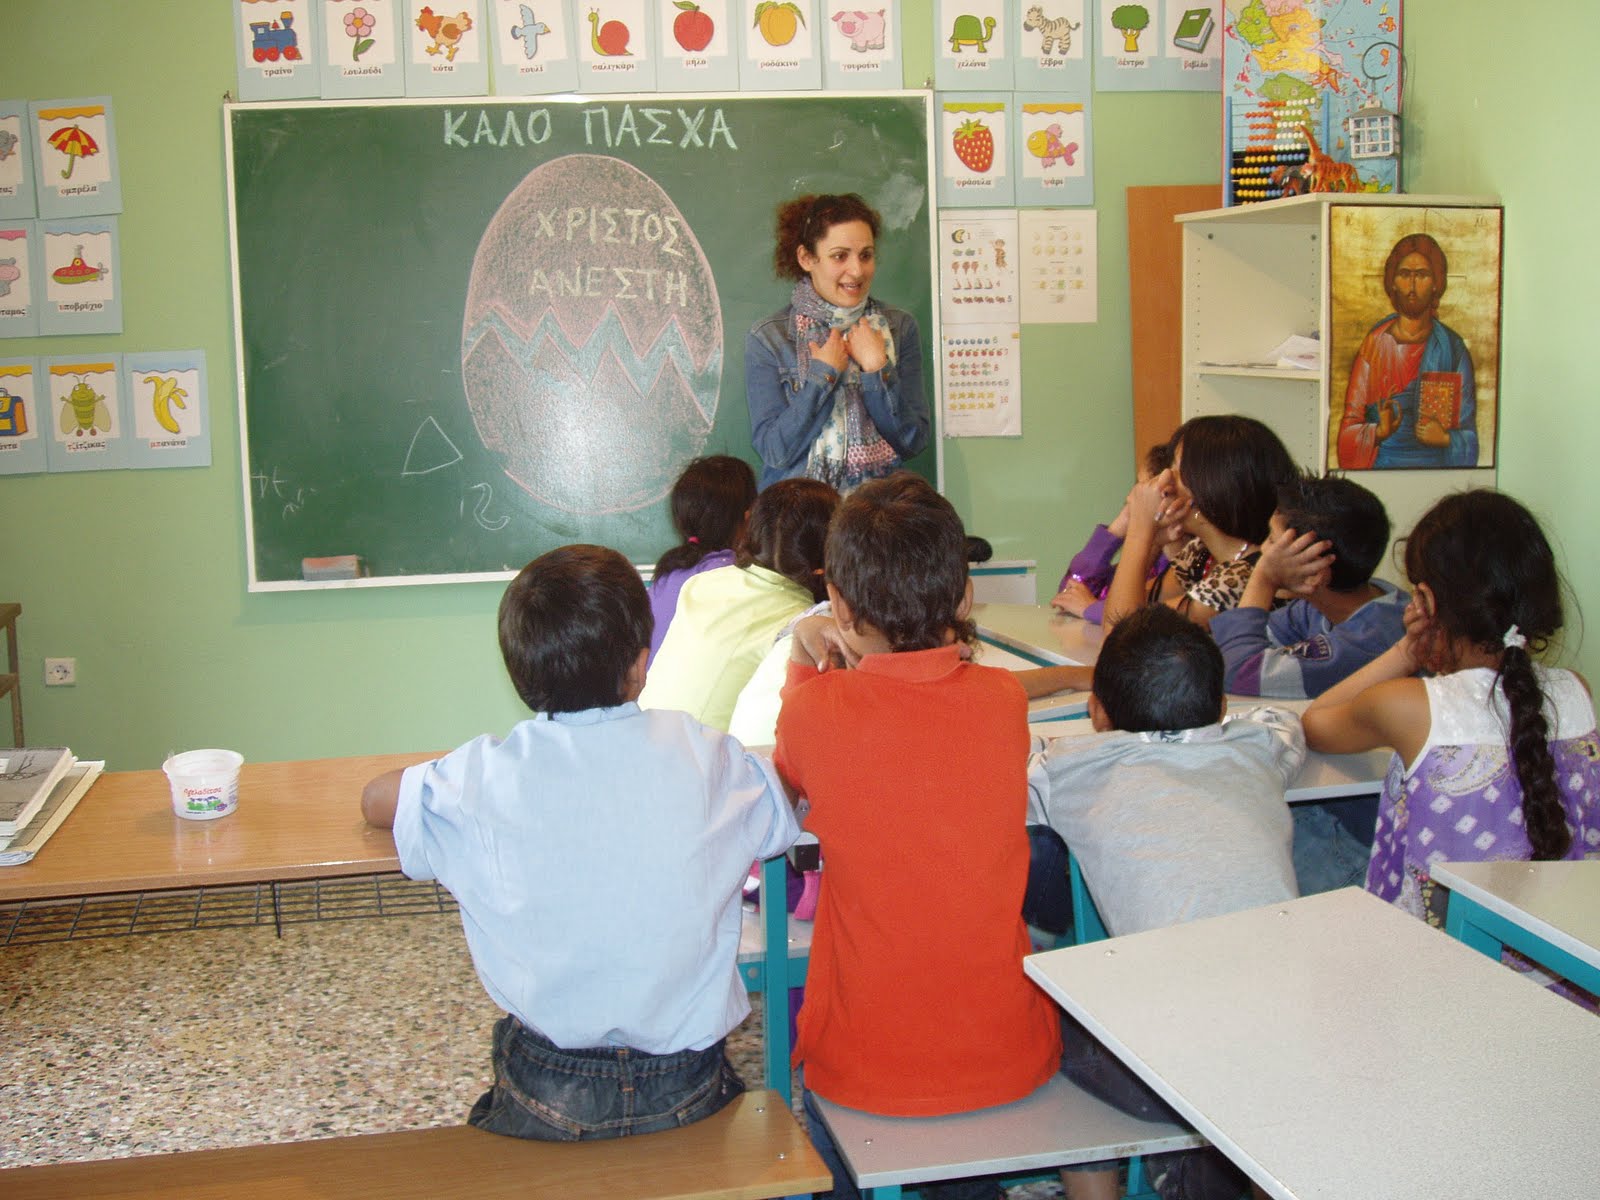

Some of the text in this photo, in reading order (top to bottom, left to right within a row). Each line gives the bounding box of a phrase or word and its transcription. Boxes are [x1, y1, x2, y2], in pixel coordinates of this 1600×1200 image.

[432, 63, 454, 73] κότα
[592, 61, 635, 71] σαλιγκάρι
[685, 58, 707, 68] μήλο
[759, 60, 799, 70] ροδάκινο
[842, 61, 880, 72] γουρούνι
[1040, 57, 1064, 68] ζέβρα
[1117, 58, 1145, 68] δέντρο
[1183, 59, 1209, 70] βιβλίο
[264, 66, 293, 77] τραίνο
[343, 66, 382, 76] λουλούδι
[519, 64, 544, 74] πουλί
[444, 103, 738, 150] ΚΑΛΟ ΠΑΣΧΑ
[955, 178, 992, 188] φράουλα
[1043, 177, 1064, 188] ψάρι
[60, 184, 98, 196] ομπρέλα
[534, 206, 684, 258] ΧΡΙΣΤΟΣ
[530, 265, 688, 307] ΑΝΕΣΤΗ
[67, 441, 106, 452] τζίτζικας
[150, 437, 187, 449] μπανάνα
